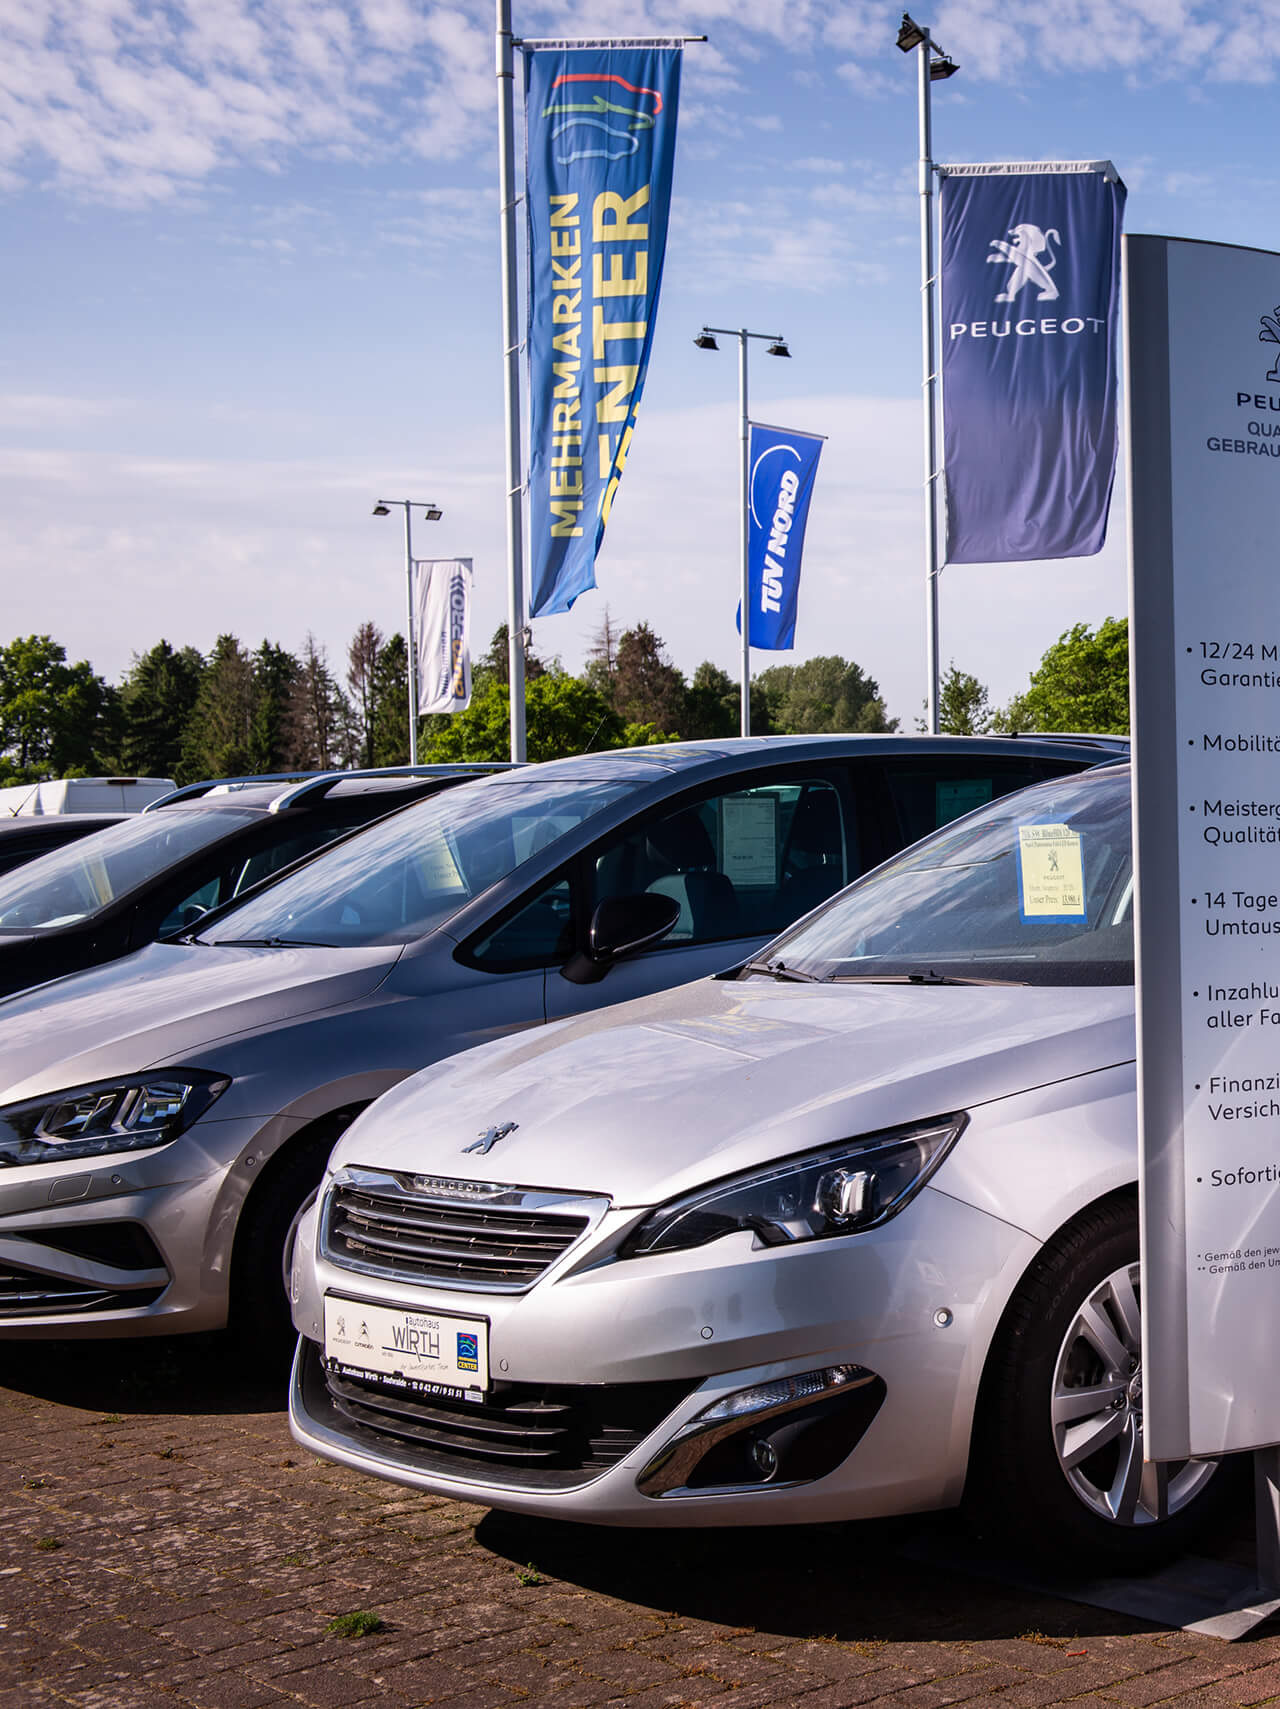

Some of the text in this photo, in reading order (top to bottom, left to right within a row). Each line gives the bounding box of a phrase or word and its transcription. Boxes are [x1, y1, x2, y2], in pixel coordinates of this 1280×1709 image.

[950, 317, 1105, 340] PEUGEOT
[550, 192, 583, 537] MEHRMARKEN
[767, 470, 799, 558] NORD
[1200, 641, 1255, 660] 12/24
[1204, 892, 1278, 912] 14 Tage
[1207, 1010, 1253, 1029] aller
[424, 1178, 481, 1193] PEUGEOT
[1204, 1250, 1242, 1262] Gemäß
[1243, 1247, 1262, 1259] den
[1209, 1262, 1246, 1274] Gemäß
[1248, 1260, 1266, 1271] den
[408, 1316, 440, 1330] autohaus
